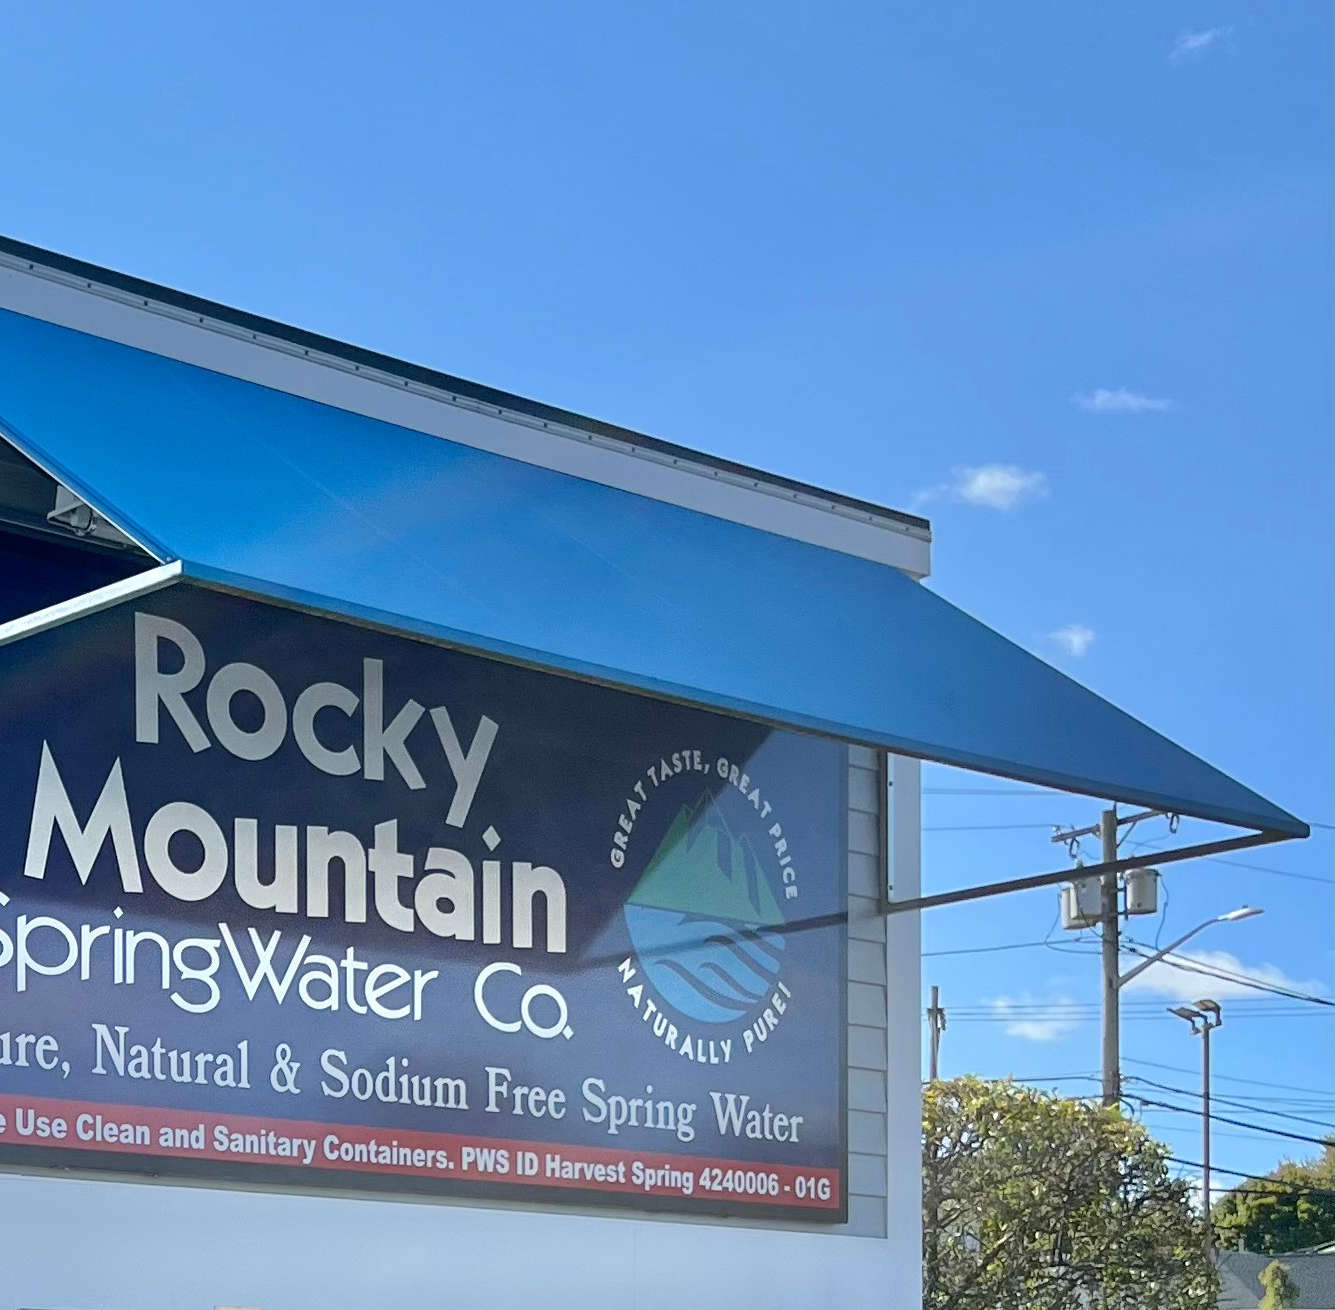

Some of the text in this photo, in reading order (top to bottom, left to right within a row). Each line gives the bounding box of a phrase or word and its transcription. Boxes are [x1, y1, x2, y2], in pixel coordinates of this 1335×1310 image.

[134, 611, 499, 829] Rocky
[24, 739, 566, 954] Mountain
[610, 749, 798, 900] GREAT TASTE, GREAT PRICE
[474, 961, 574, 1041] Co.
[617, 956, 792, 1065] NATURALLY PURE!
[91, 1023, 251, 1089] Natural
[270, 1042, 301, 1096] &
[320, 1048, 469, 1110] Sodium
[484, 1066, 567, 1120] Free
[581, 1077, 697, 1143] Spring
[709, 1091, 804, 1144] Water
[15, 1107, 68, 1139] Use
[76, 1113, 151, 1146] Clean
[158, 1123, 205, 1151] and
[212, 1125, 316, 1164] Sanitary
[323, 1134, 455, 1170] Containers.
[461, 1146, 510, 1174] PWS
[516, 1151, 539, 1176] ID
[544, 1154, 625, 1184] Harvest
[631, 1162, 695, 1195] Spring
[698, 1166, 779, 1194] 4240006
